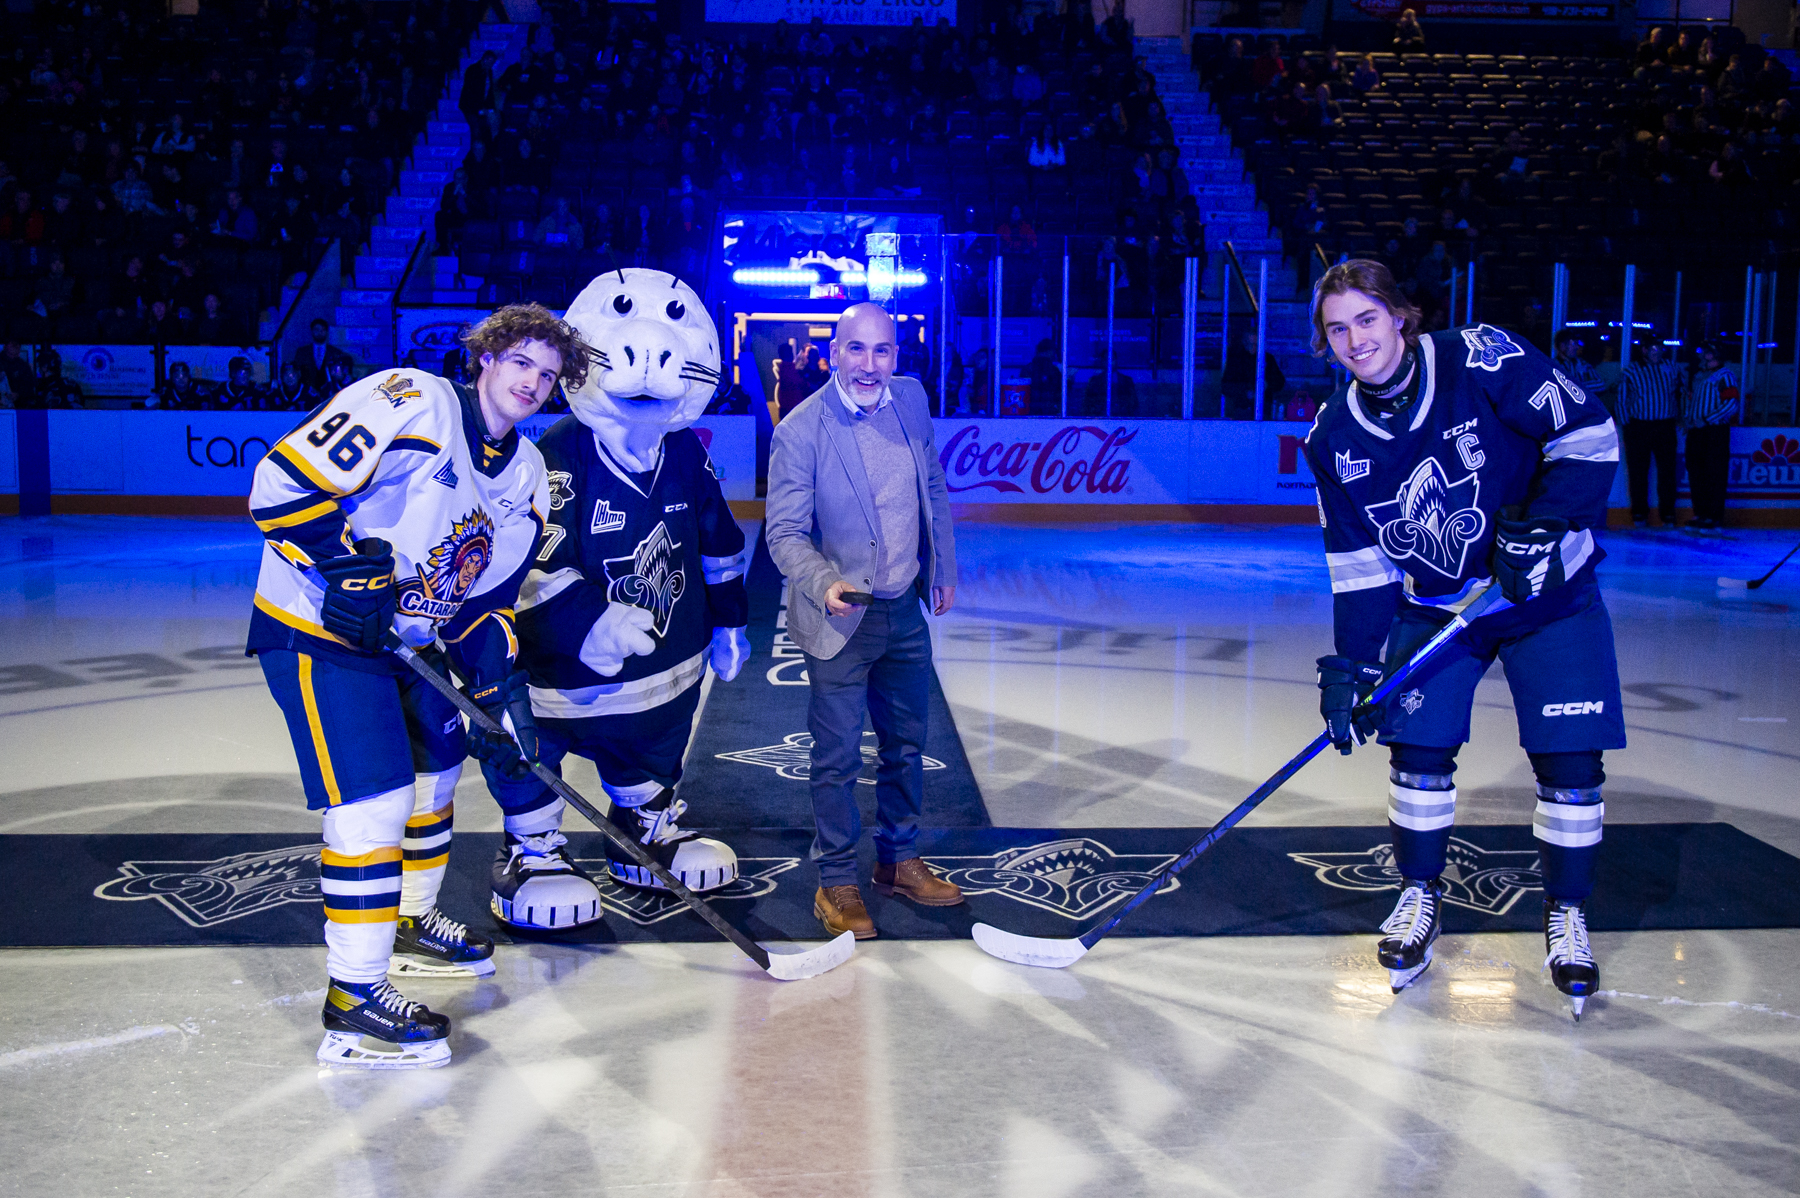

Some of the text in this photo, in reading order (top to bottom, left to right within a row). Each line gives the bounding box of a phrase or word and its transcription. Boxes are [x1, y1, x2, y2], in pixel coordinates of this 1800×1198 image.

[1442, 418, 1478, 440] CCM
[187, 425, 271, 467] tan
[306, 412, 377, 473] 96
[1456, 433, 1486, 471] C
[939, 425, 1138, 493] Coca-Cola
[1496, 533, 1556, 556] CCM
[341, 573, 393, 592] CC
[474, 686, 498, 700] CCM
[1542, 701, 1604, 717] CCM
